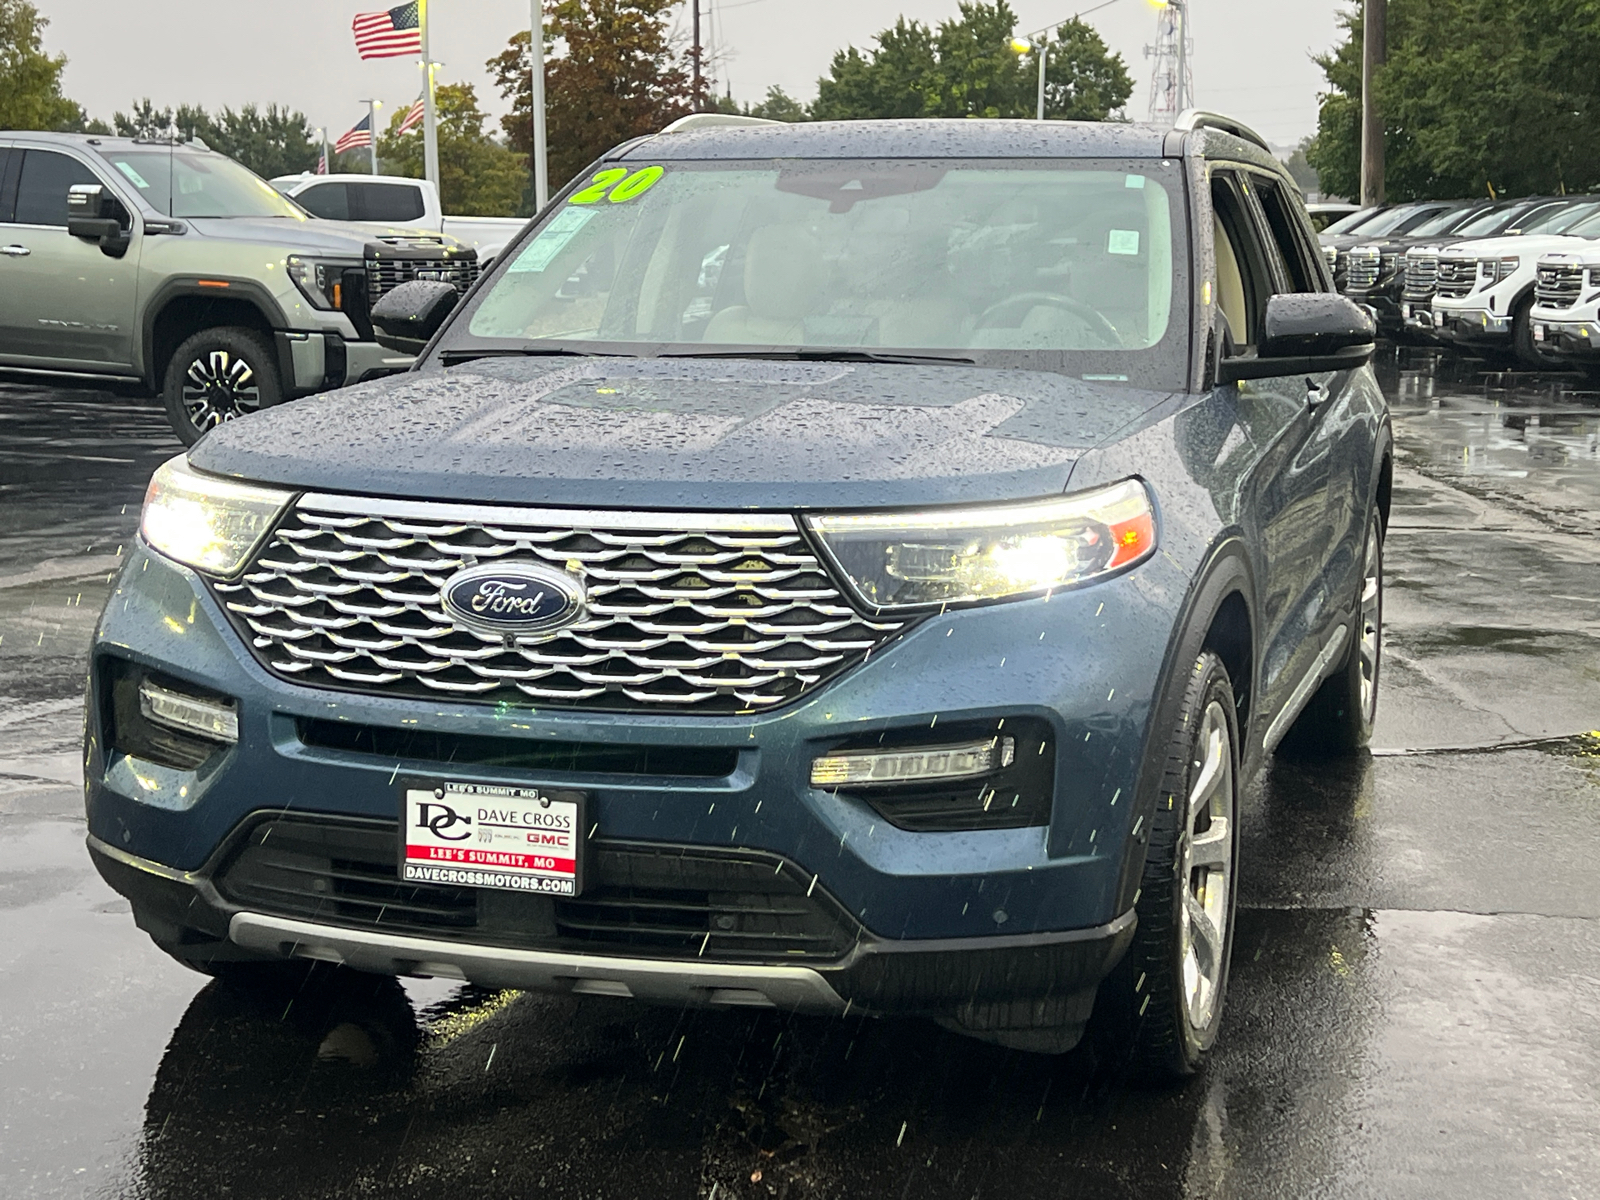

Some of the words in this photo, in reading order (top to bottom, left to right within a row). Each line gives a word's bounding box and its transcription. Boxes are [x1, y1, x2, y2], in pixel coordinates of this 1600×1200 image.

[567, 165, 665, 205] 20
[471, 580, 544, 614] Ford
[446, 784, 474, 793] LEE'S
[476, 786, 516, 796] SUMMIT
[520, 789, 536, 797] MO
[478, 808, 518, 823] DAVE
[523, 812, 570, 828] CROSS
[527, 833, 569, 846] GMC
[429, 848, 465, 860] LEE'S
[469, 851, 529, 867] SUMMIT,
[533, 857, 555, 868] MO
[406, 866, 573, 893] DAVECROSSMOTORS.COM
